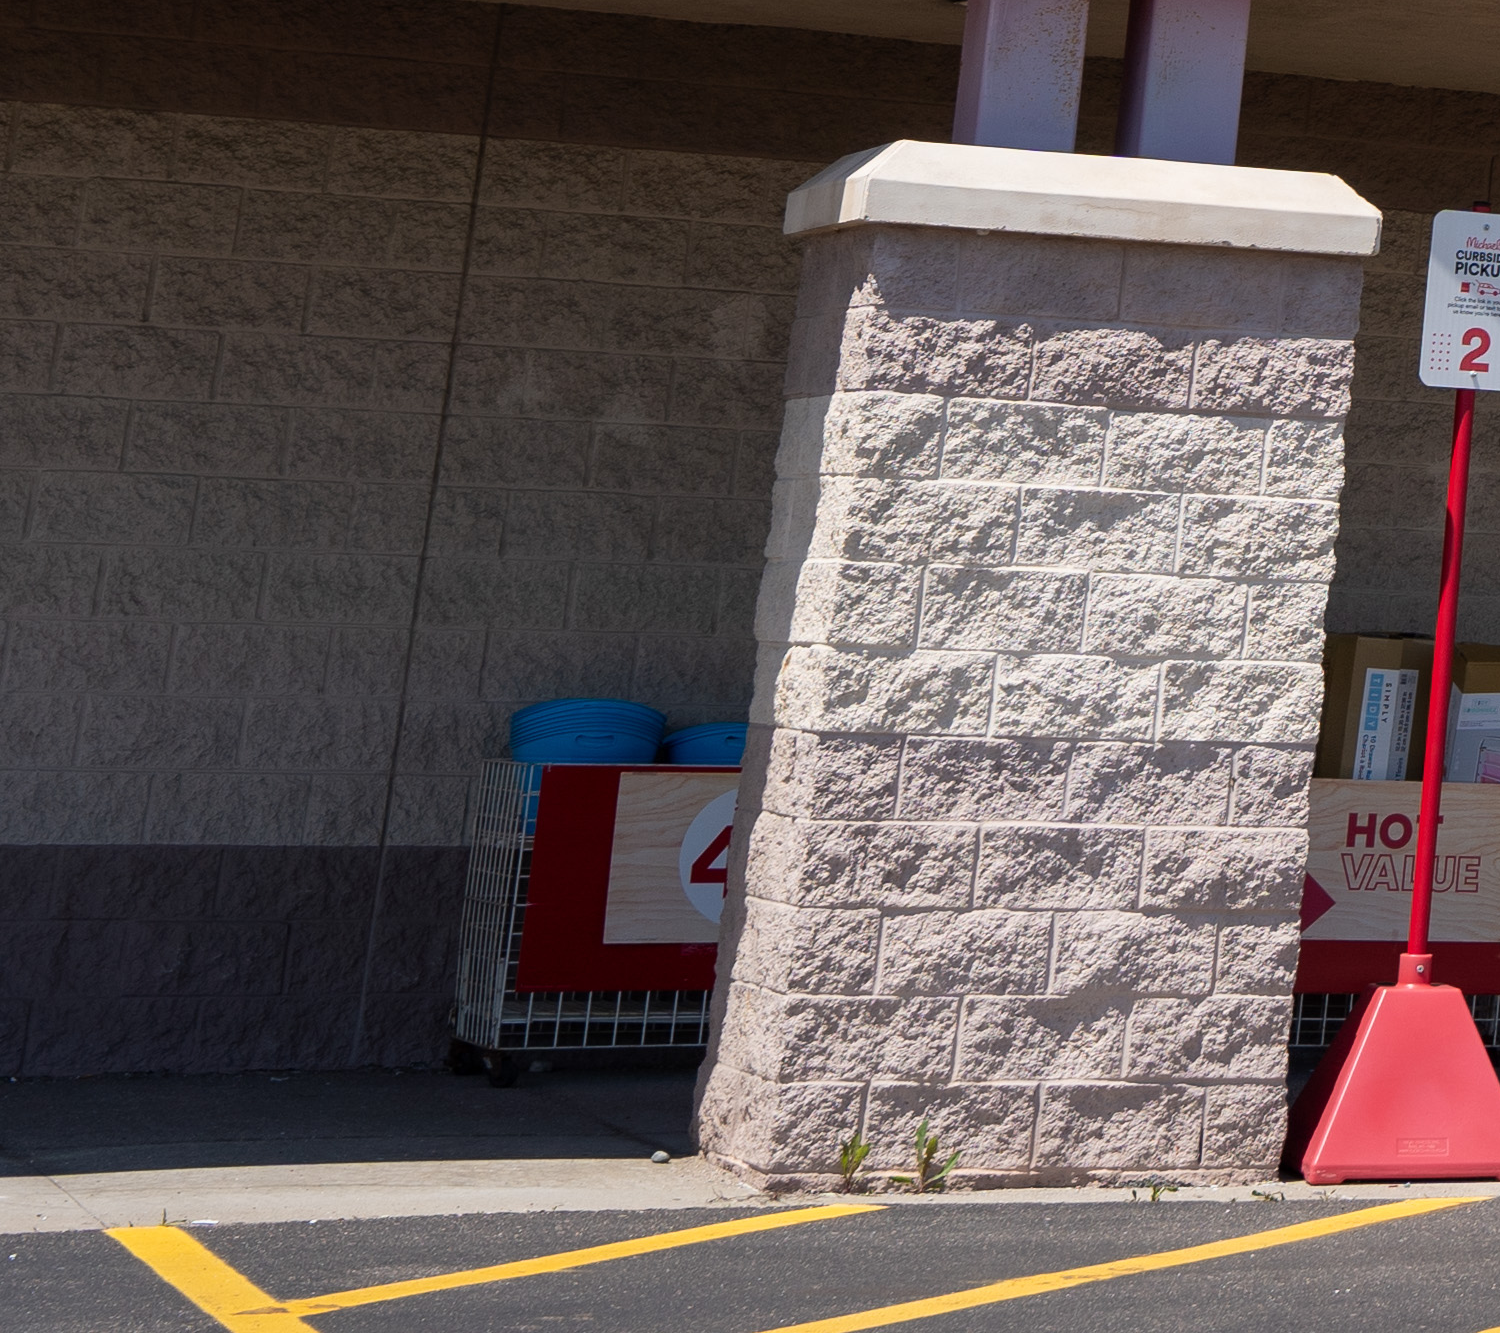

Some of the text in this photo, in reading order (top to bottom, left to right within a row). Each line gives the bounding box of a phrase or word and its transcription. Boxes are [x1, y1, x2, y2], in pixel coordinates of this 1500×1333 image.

[1459, 327, 1491, 373] 2
[1367, 677, 1381, 727] TIDY
[1381, 682, 1392, 724] SIMPLY
